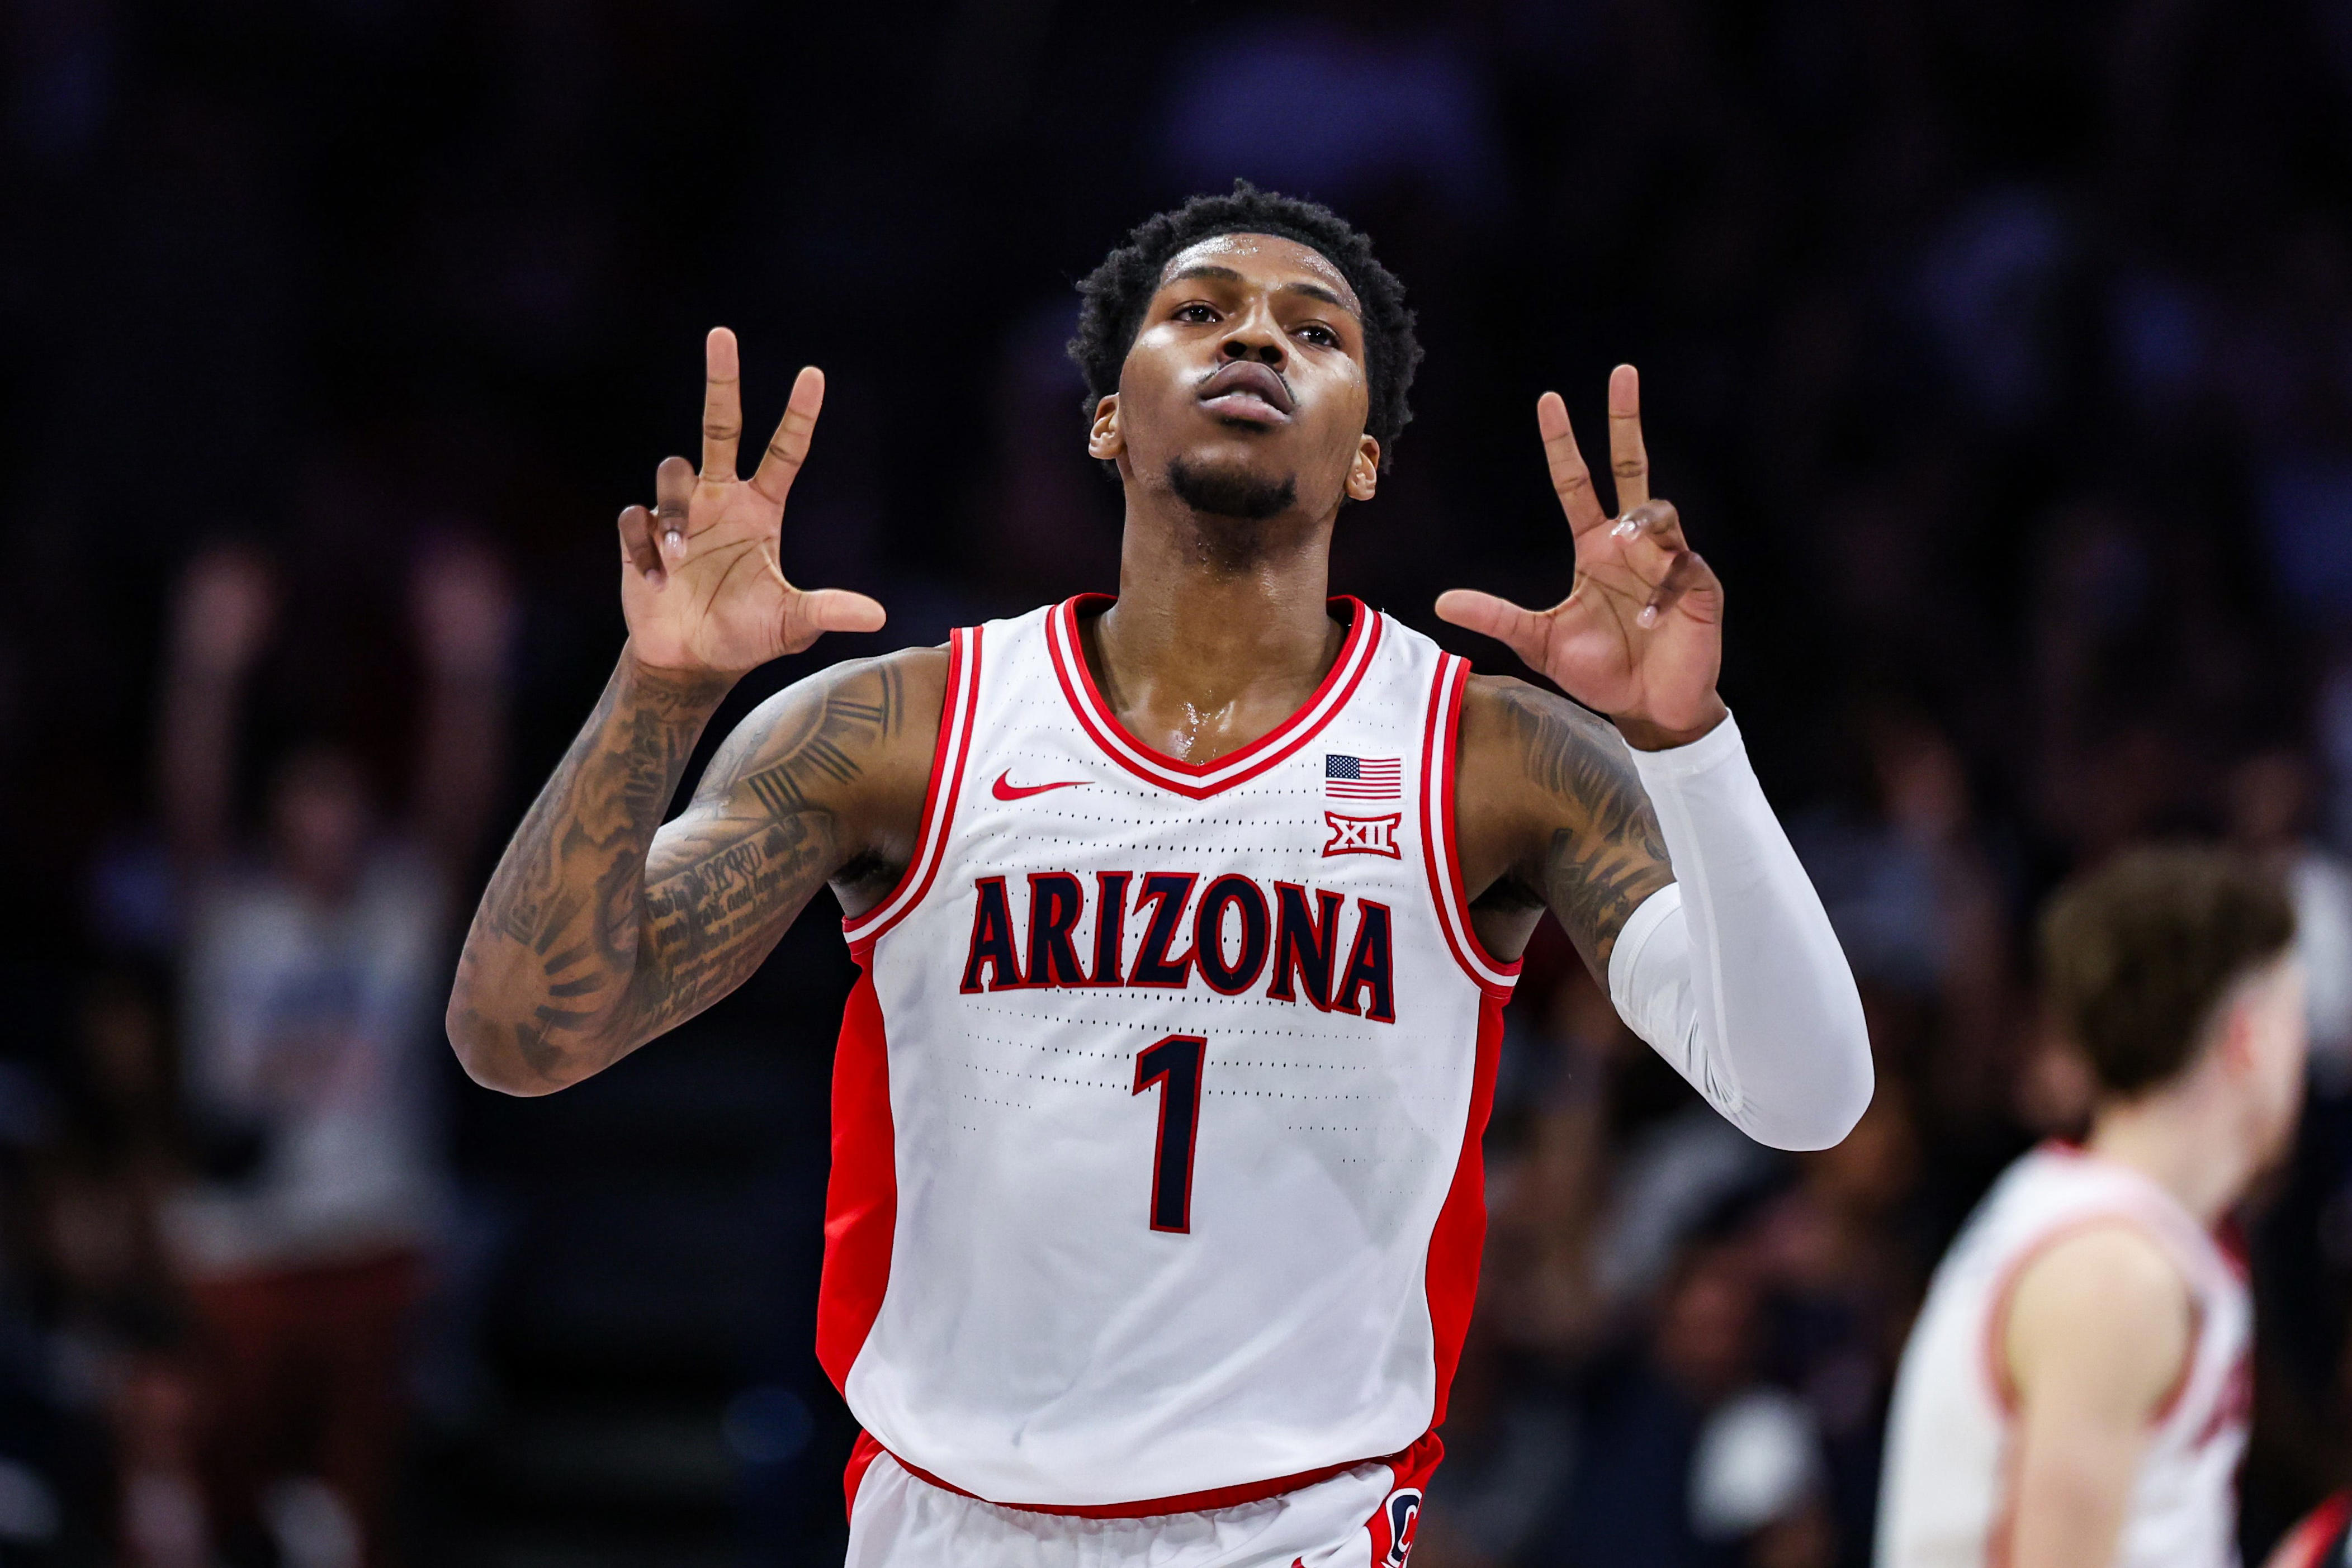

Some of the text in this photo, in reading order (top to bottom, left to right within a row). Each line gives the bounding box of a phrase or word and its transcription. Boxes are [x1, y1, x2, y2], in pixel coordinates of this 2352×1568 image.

[1327, 814, 1398, 855] XII
[960, 870, 1395, 1024] ARIZONA
[1132, 1034, 1208, 1234] 1
